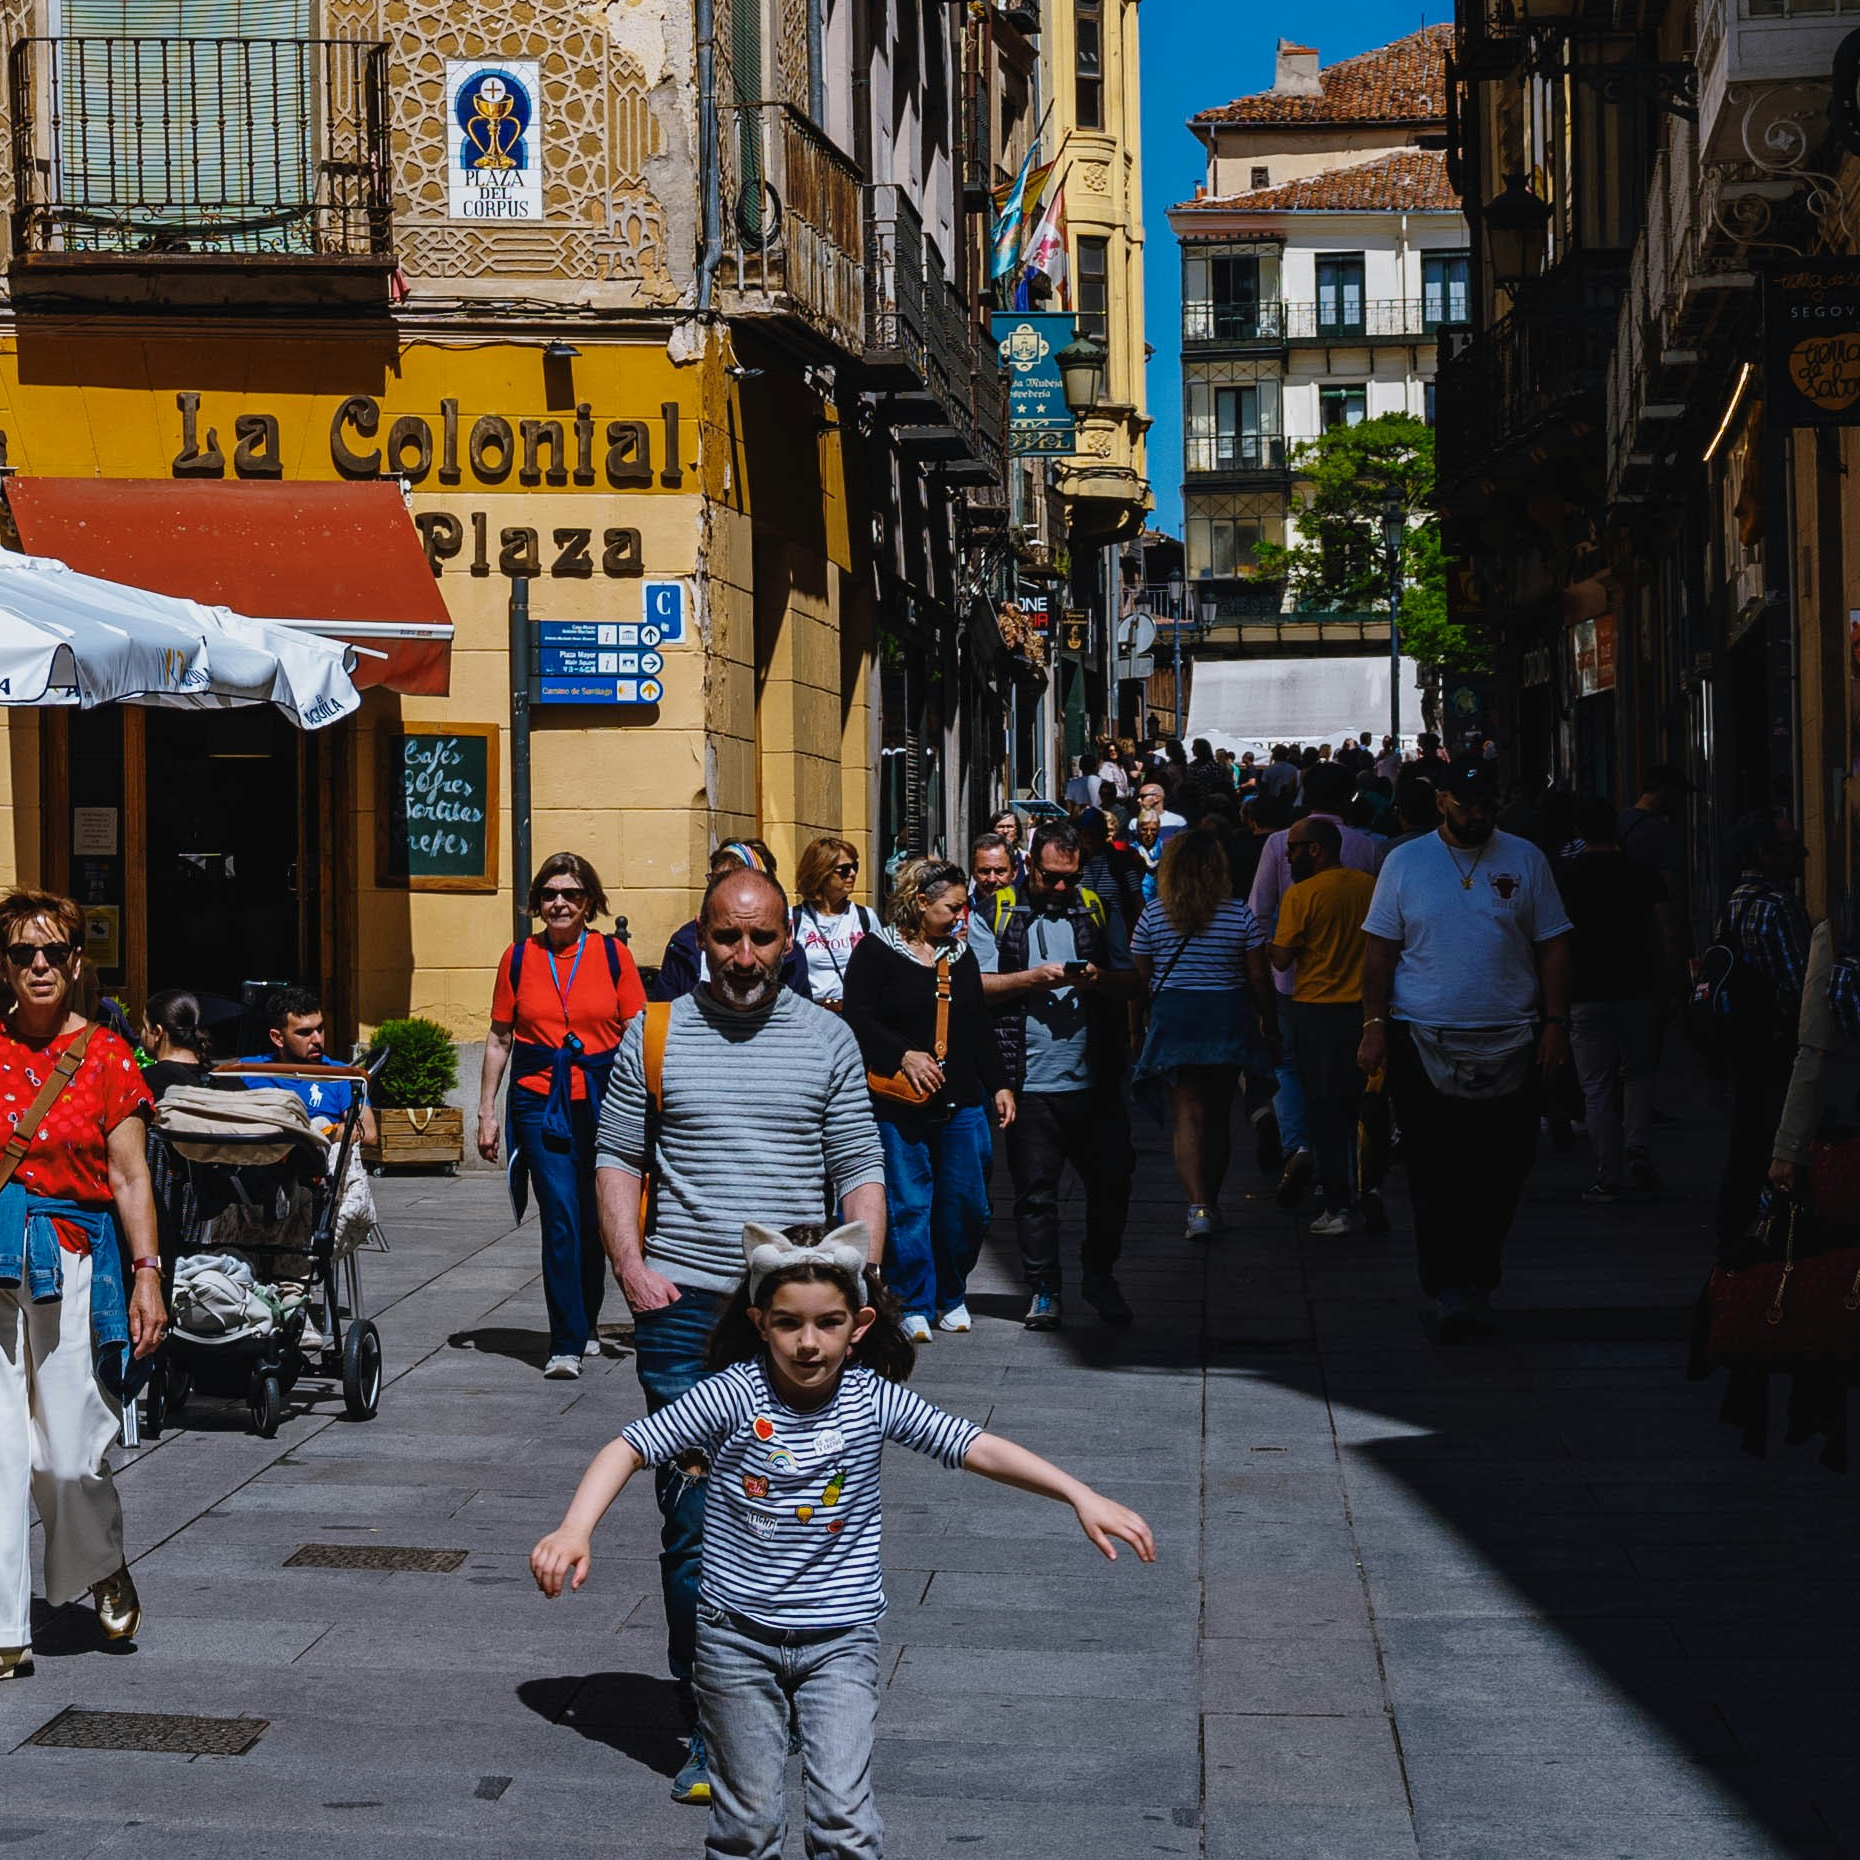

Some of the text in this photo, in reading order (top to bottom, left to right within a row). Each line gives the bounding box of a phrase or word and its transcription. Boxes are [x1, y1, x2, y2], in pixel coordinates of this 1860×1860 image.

[465, 169, 524, 187] PLAZA
[480, 187, 512, 199] DEL
[463, 200, 529, 217] CORPUS
[1026, 377, 1063, 389] Mudéja
[1804, 363, 1860, 399] sabo
[172, 391, 683, 488] La Colonial
[416, 511, 646, 579] Plaza
[656, 590, 671, 616] C
[559, 650, 597, 660] Plaza Mayor
[542, 687, 613, 697] Camino de Santiago
[404, 738, 463, 774] Cafés
[407, 829, 472, 857] repes
